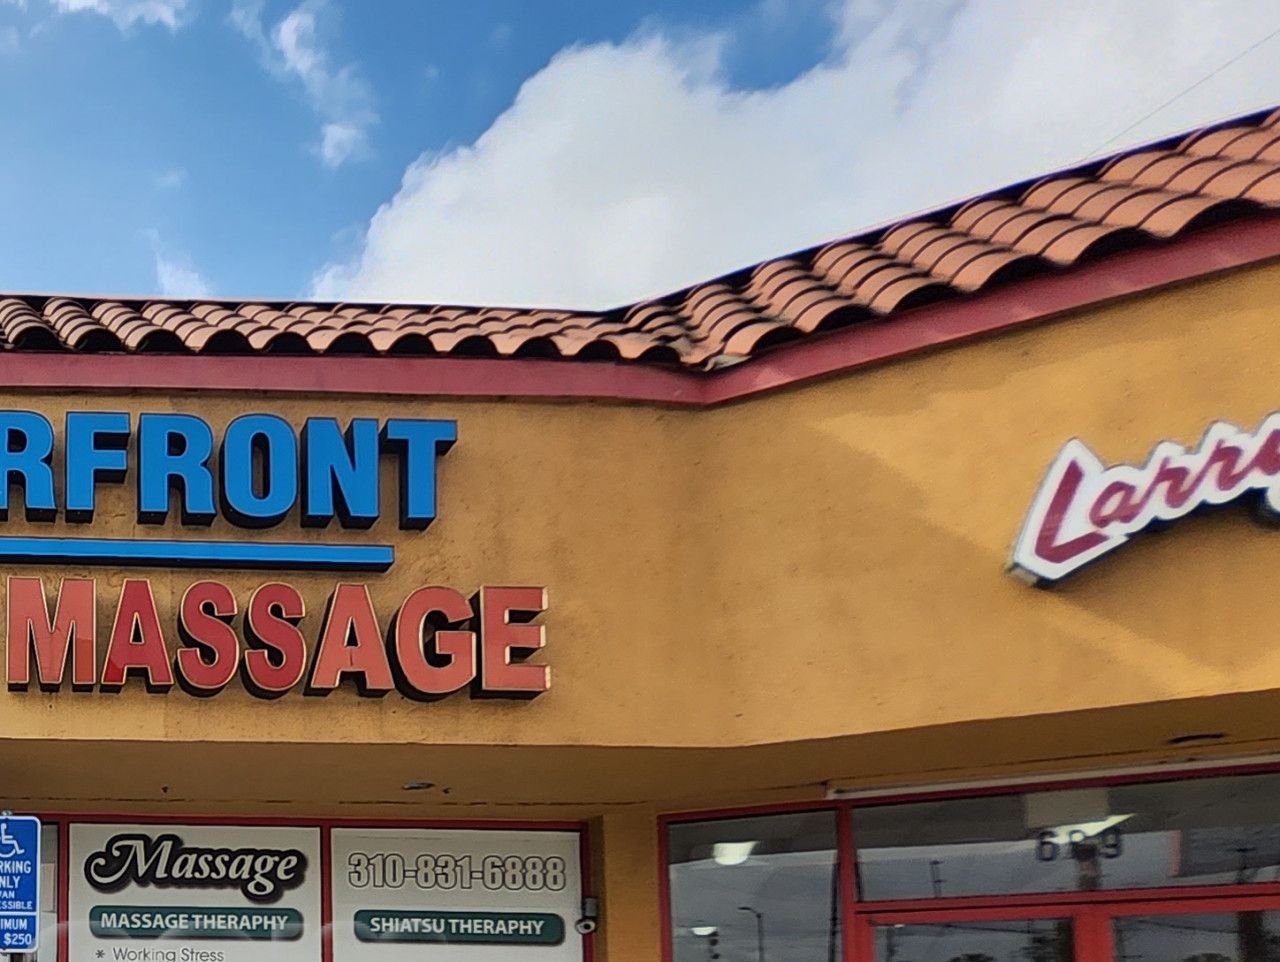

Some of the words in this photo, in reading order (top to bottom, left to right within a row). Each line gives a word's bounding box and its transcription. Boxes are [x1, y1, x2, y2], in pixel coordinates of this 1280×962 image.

[5, 575, 552, 700] MASSAGE
[86, 836, 303, 900] Massage
[348, 852, 567, 891] 310-831-6888
[101, 913, 189, 929] MASSAGE
[192, 914, 288, 931] THERAPHY
[370, 917, 445, 933] SHIATSU
[448, 918, 545, 935] THERAPHY
[4, 932, 32, 945] $250
[180, 947, 225, 962] Stress
